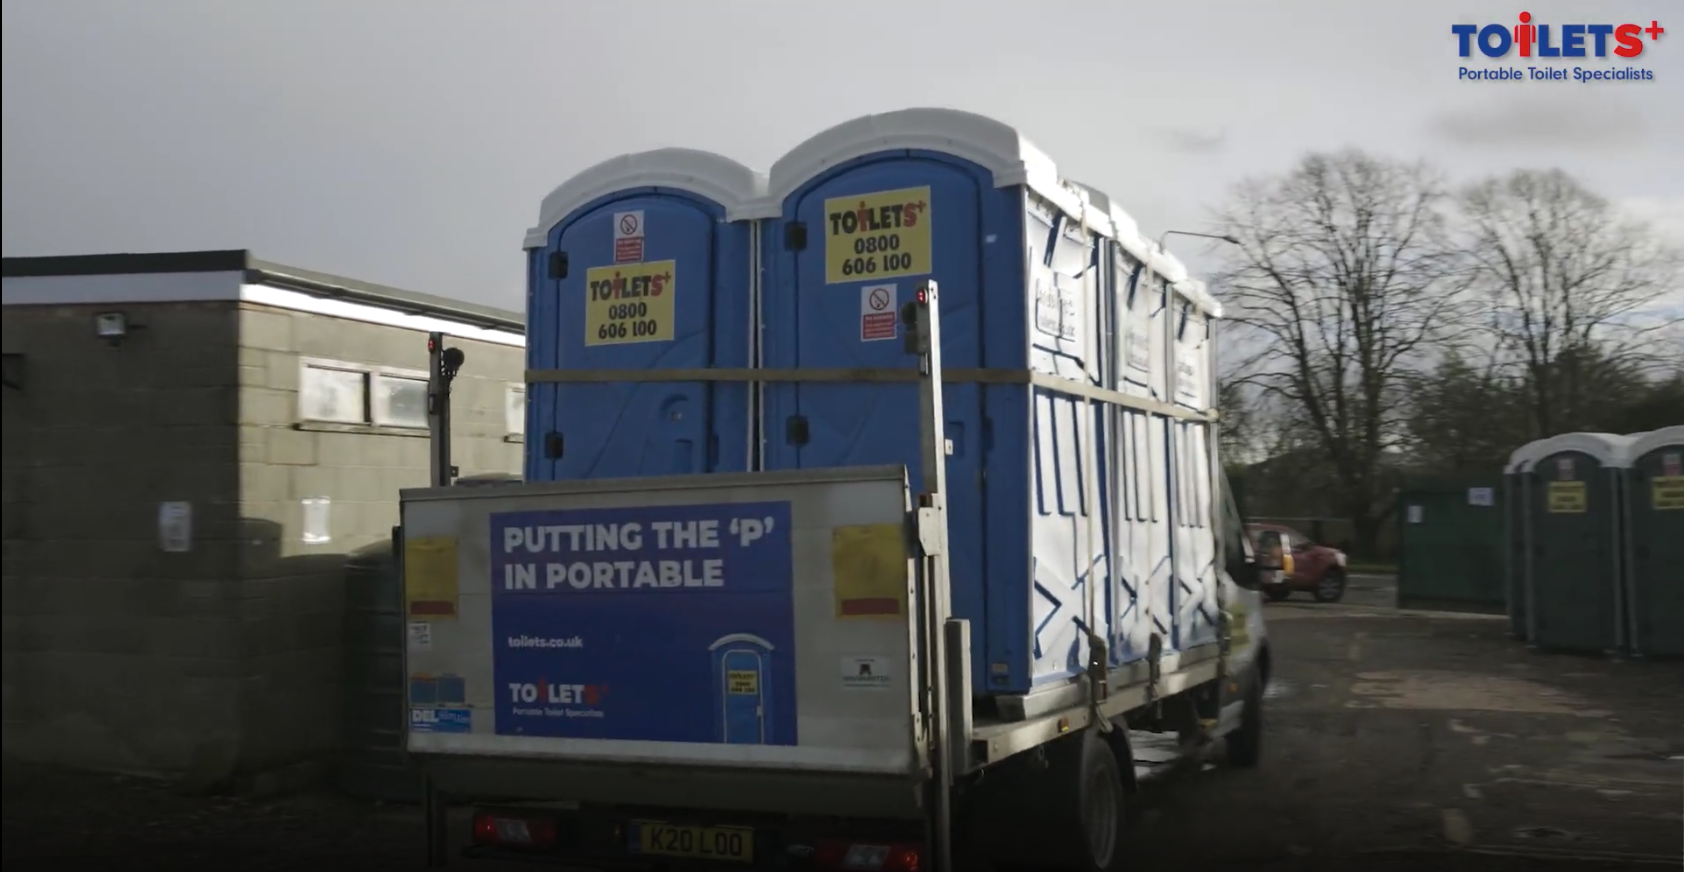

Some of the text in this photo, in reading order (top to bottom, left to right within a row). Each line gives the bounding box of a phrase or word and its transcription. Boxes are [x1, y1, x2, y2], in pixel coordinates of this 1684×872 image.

[854, 233, 900, 255] 0800
[842, 252, 912, 276] 606 100
[608, 302, 648, 321] 0800
[598, 319, 658, 340] 606 100
[503, 523, 643, 553] PUTTING
[651, 520, 720, 549] THE
[504, 559, 725, 590] IN PORTABLE
[507, 634, 584, 648] toilets.co.uk
[650, 827, 693, 852] K20
